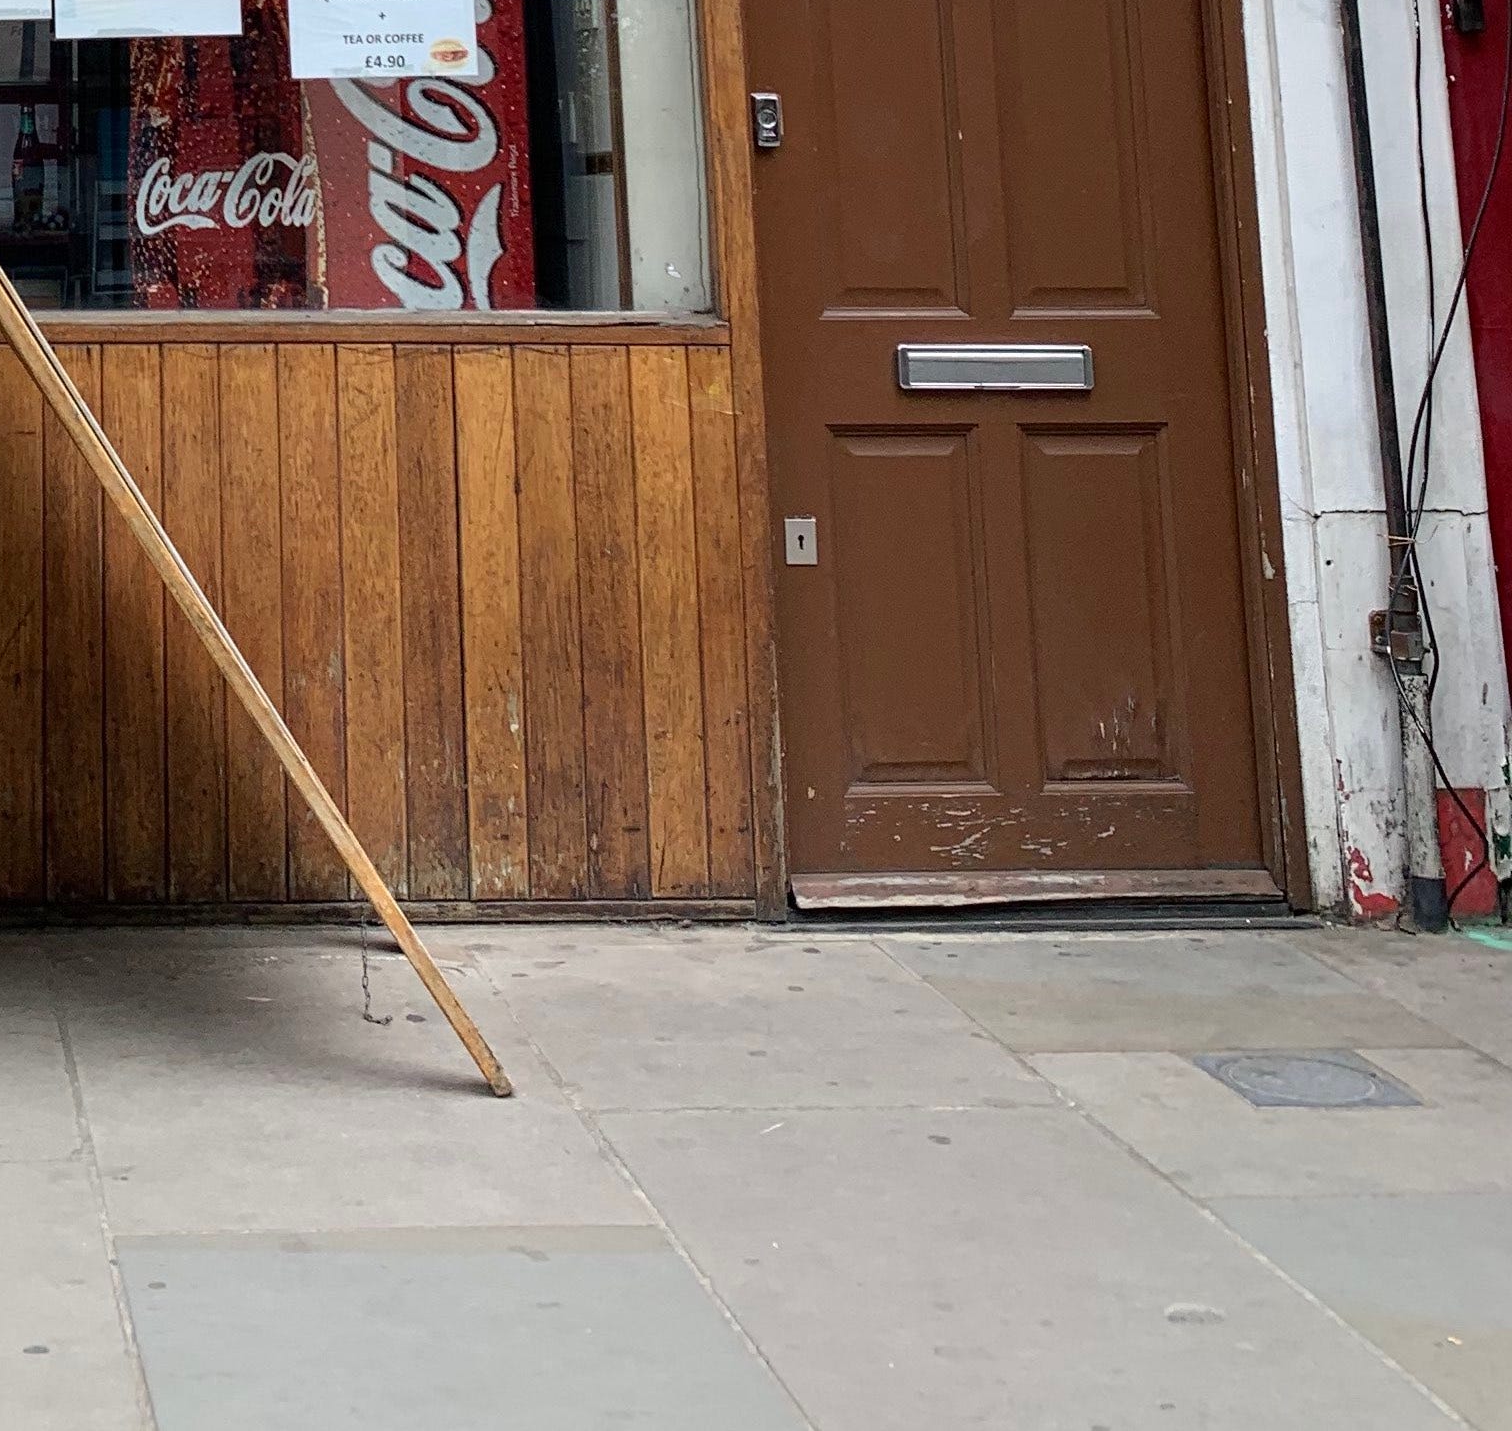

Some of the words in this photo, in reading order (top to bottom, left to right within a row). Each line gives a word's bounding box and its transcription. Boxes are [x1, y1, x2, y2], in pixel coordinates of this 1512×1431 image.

[343, 34, 363, 45] TEA
[366, 34, 382, 44] OR
[384, 33, 425, 44] COFFEE
[365, 55, 406, 68] £4.90
[135, 151, 319, 235] Coca-Cola
